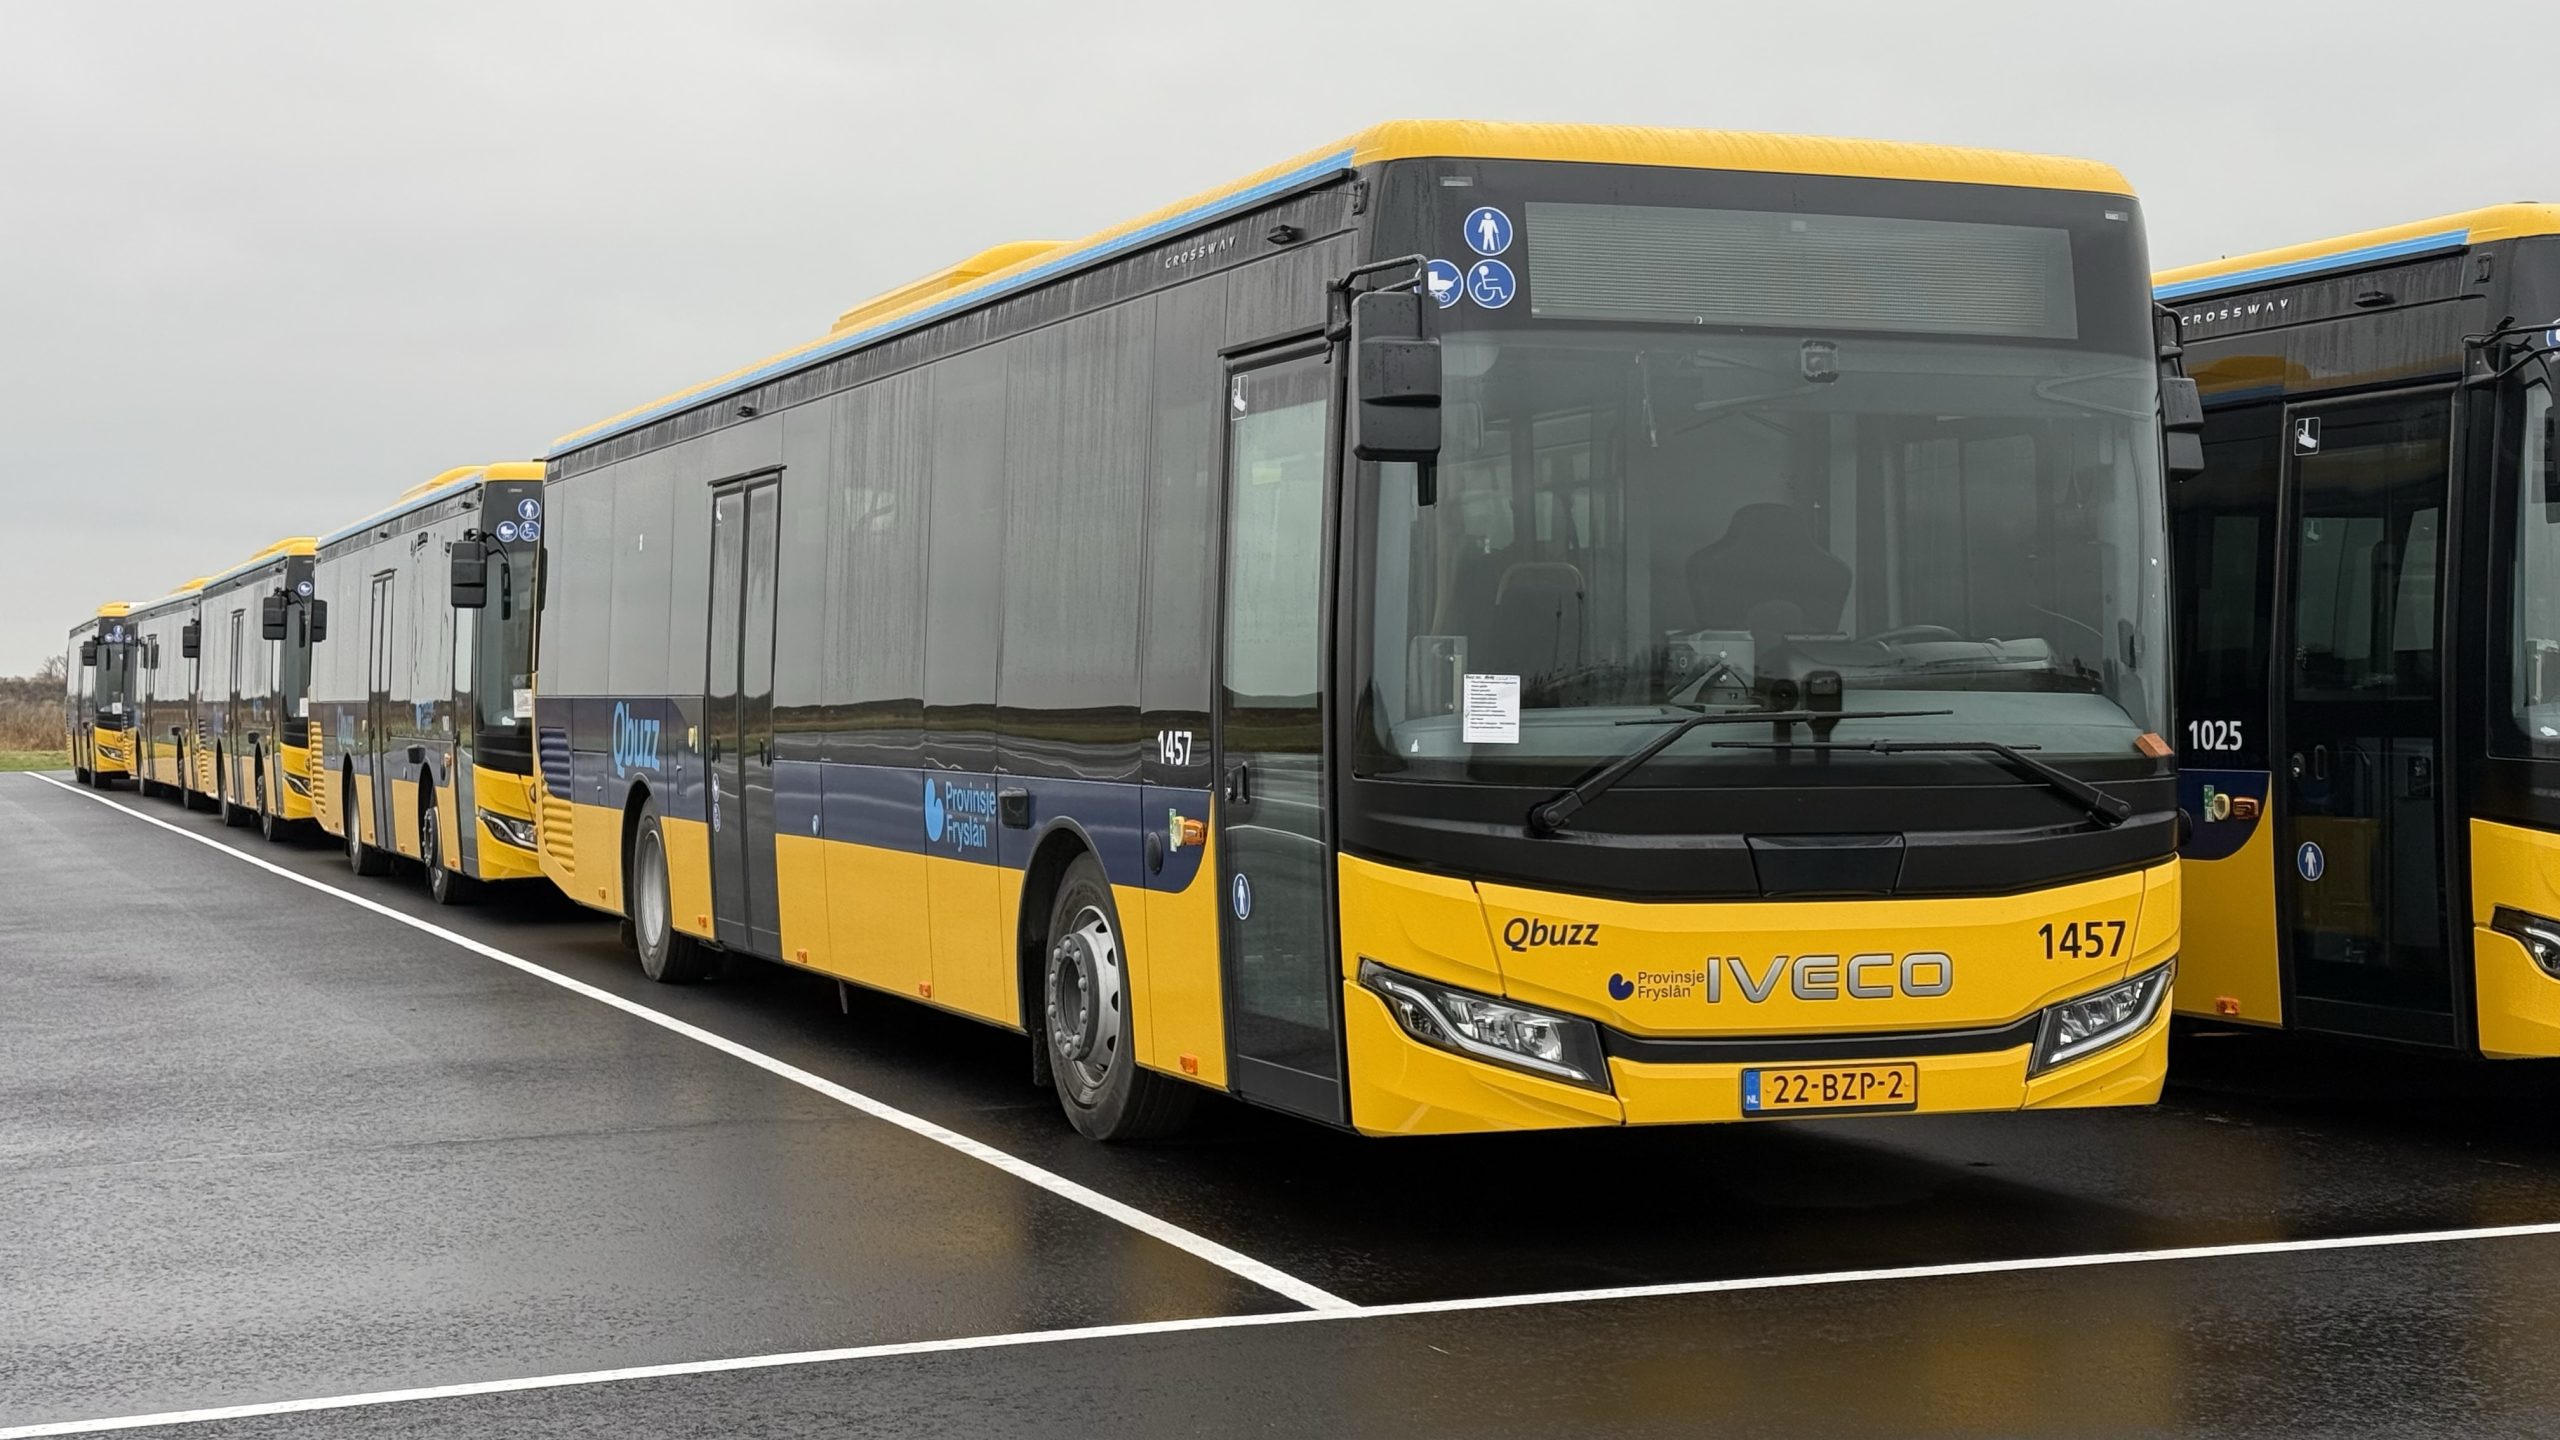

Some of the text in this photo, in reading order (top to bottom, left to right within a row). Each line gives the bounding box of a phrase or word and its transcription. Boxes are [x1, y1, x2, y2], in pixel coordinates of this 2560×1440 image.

[1165, 236, 1236, 269] CROSSWAY
[2181, 298, 2289, 326] CROSSWAY
[613, 701, 660, 779] Qbuzz
[1157, 730, 1193, 766] 1457
[2188, 720, 2243, 751] 1025
[945, 781, 997, 823] Provinsje
[946, 814, 987, 853] Fryslân
[1503, 917, 1600, 952] Qbuzz
[2038, 920, 2127, 960] 1457
[1638, 969, 1705, 987] Provinsje
[1638, 984, 1691, 1002] Fryslân
[1707, 952, 1953, 1003] IVECO
[1746, 1070, 1904, 1105] NL 22-BZP-2
